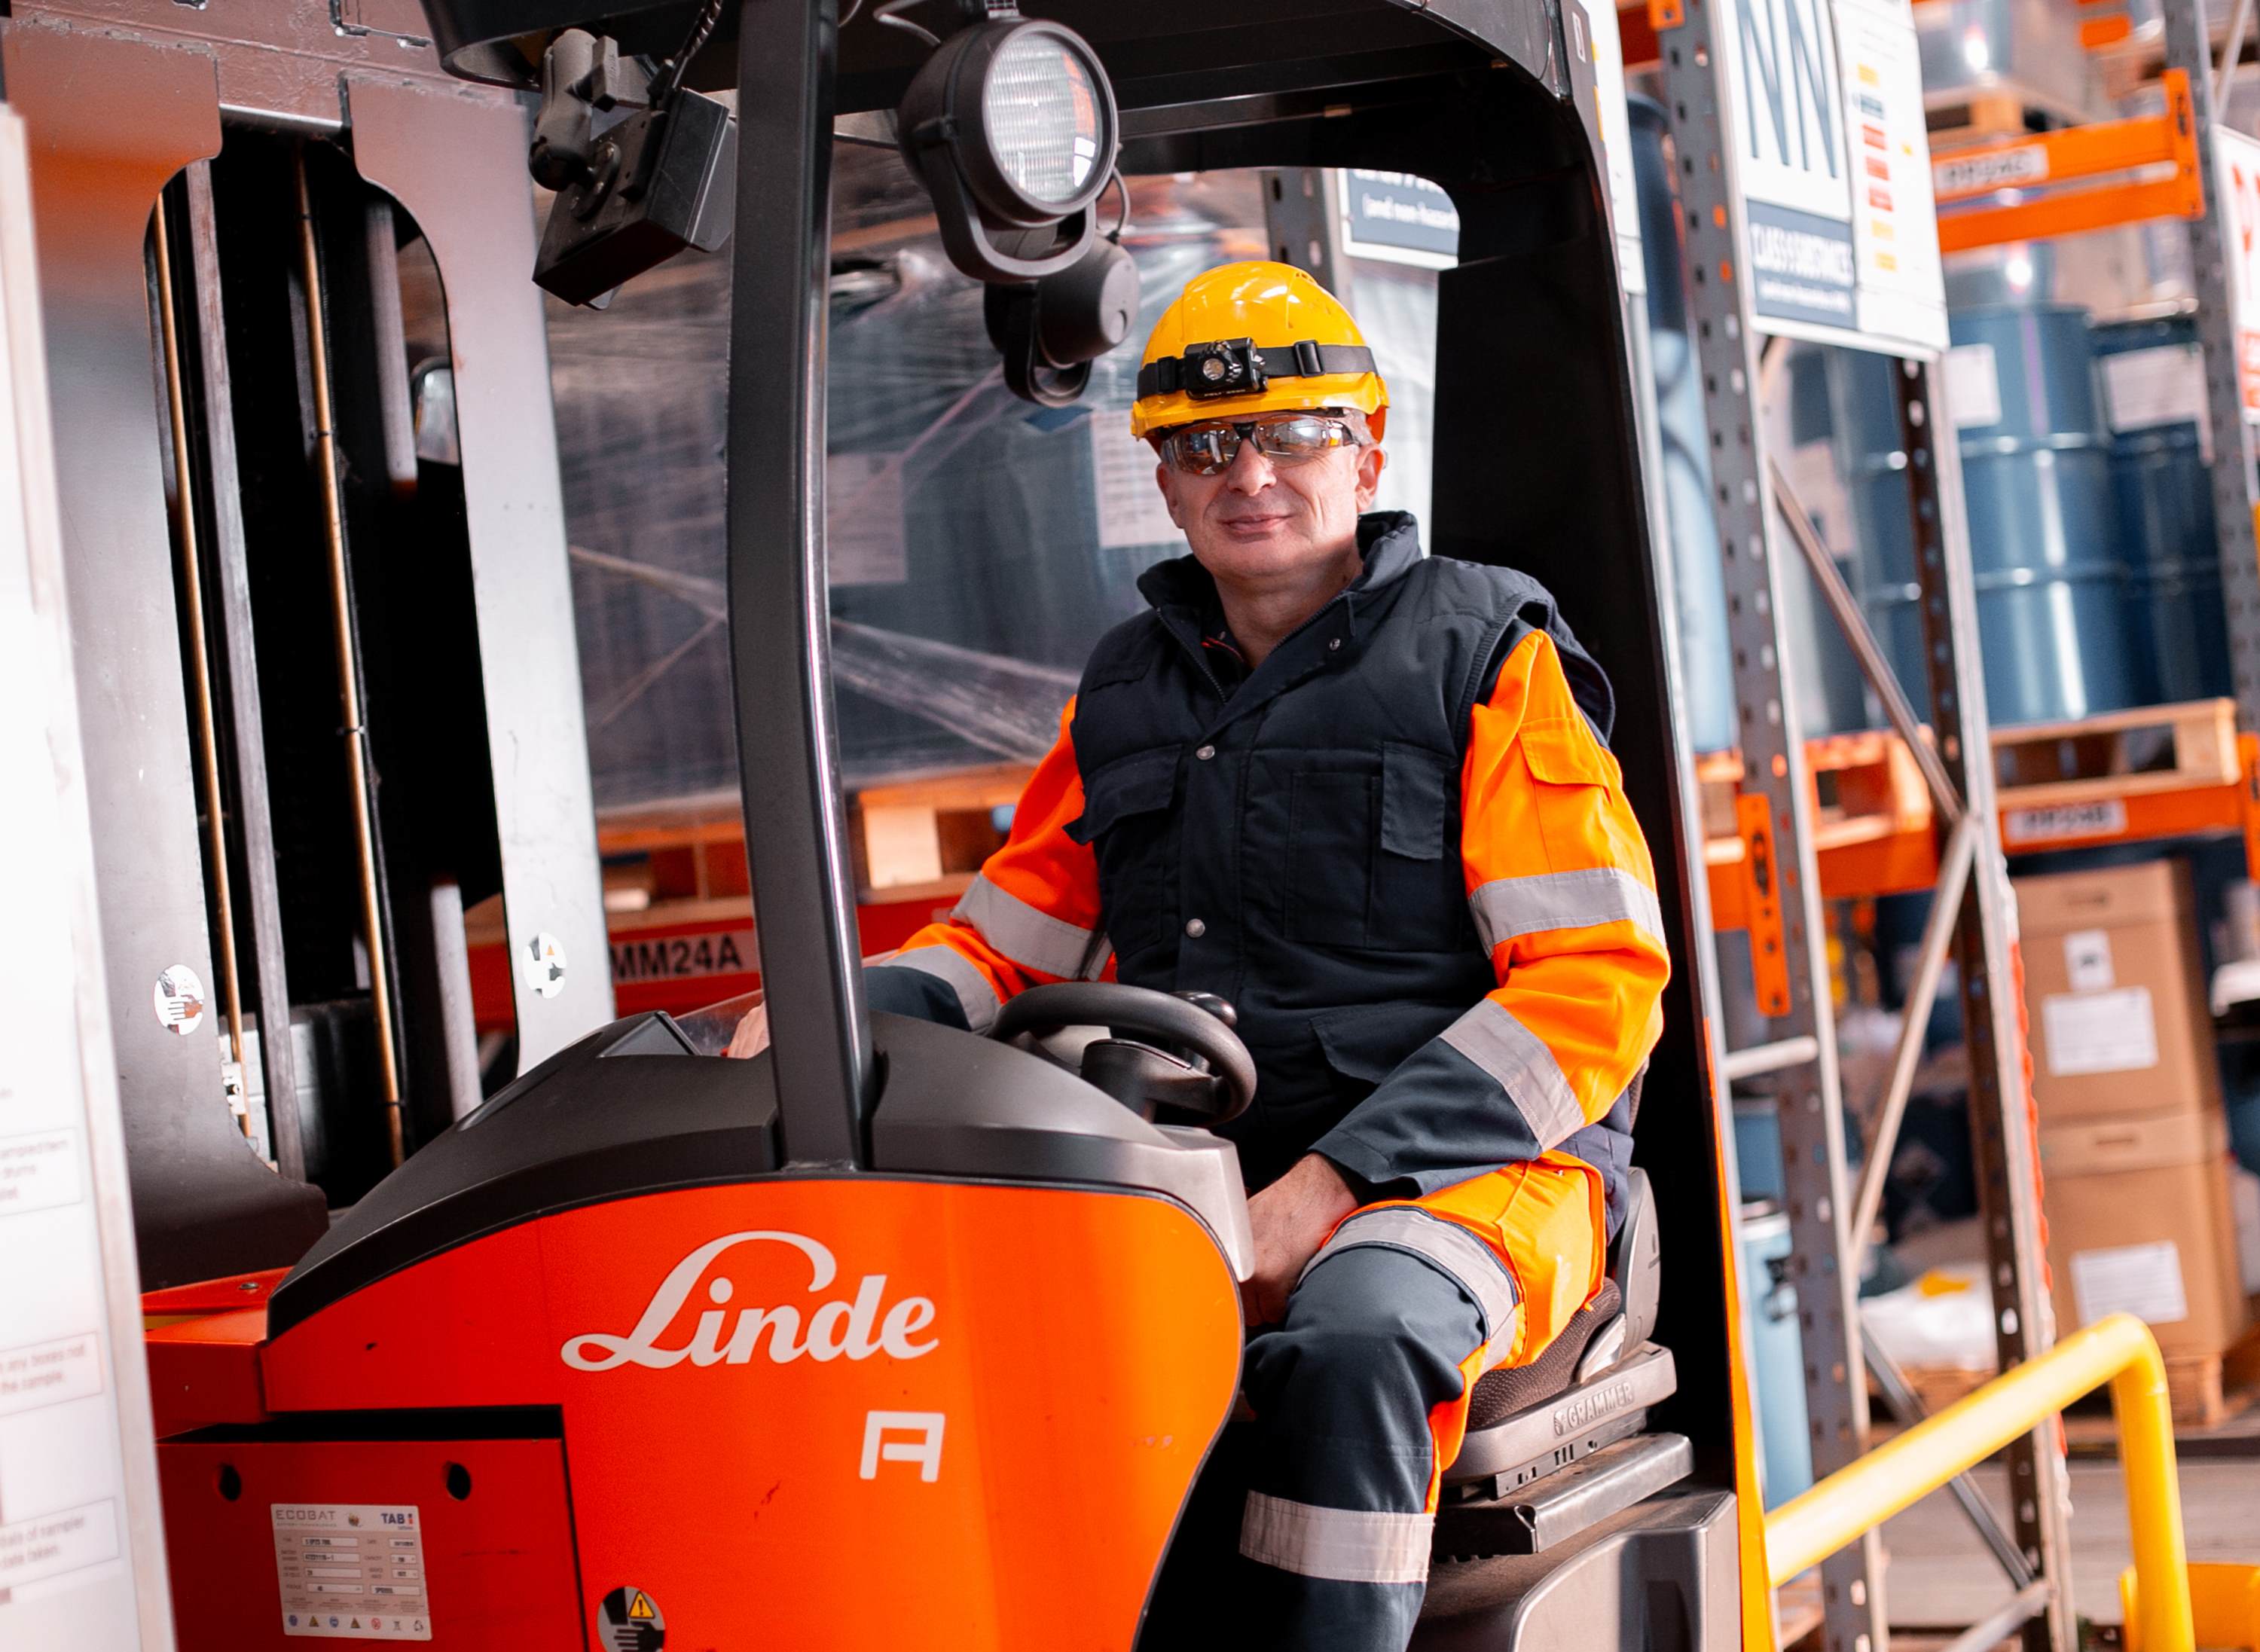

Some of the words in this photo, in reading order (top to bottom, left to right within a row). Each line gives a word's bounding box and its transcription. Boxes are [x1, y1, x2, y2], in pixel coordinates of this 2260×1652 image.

[610, 934, 742, 978] MM24A
[560, 1230, 939, 1371] Linde
[1567, 1382, 1635, 1428] GRAMMER
[859, 1410, 945, 1483] A
[276, 1509, 336, 1521] ECOBAT
[380, 1513, 405, 1525] TAB
